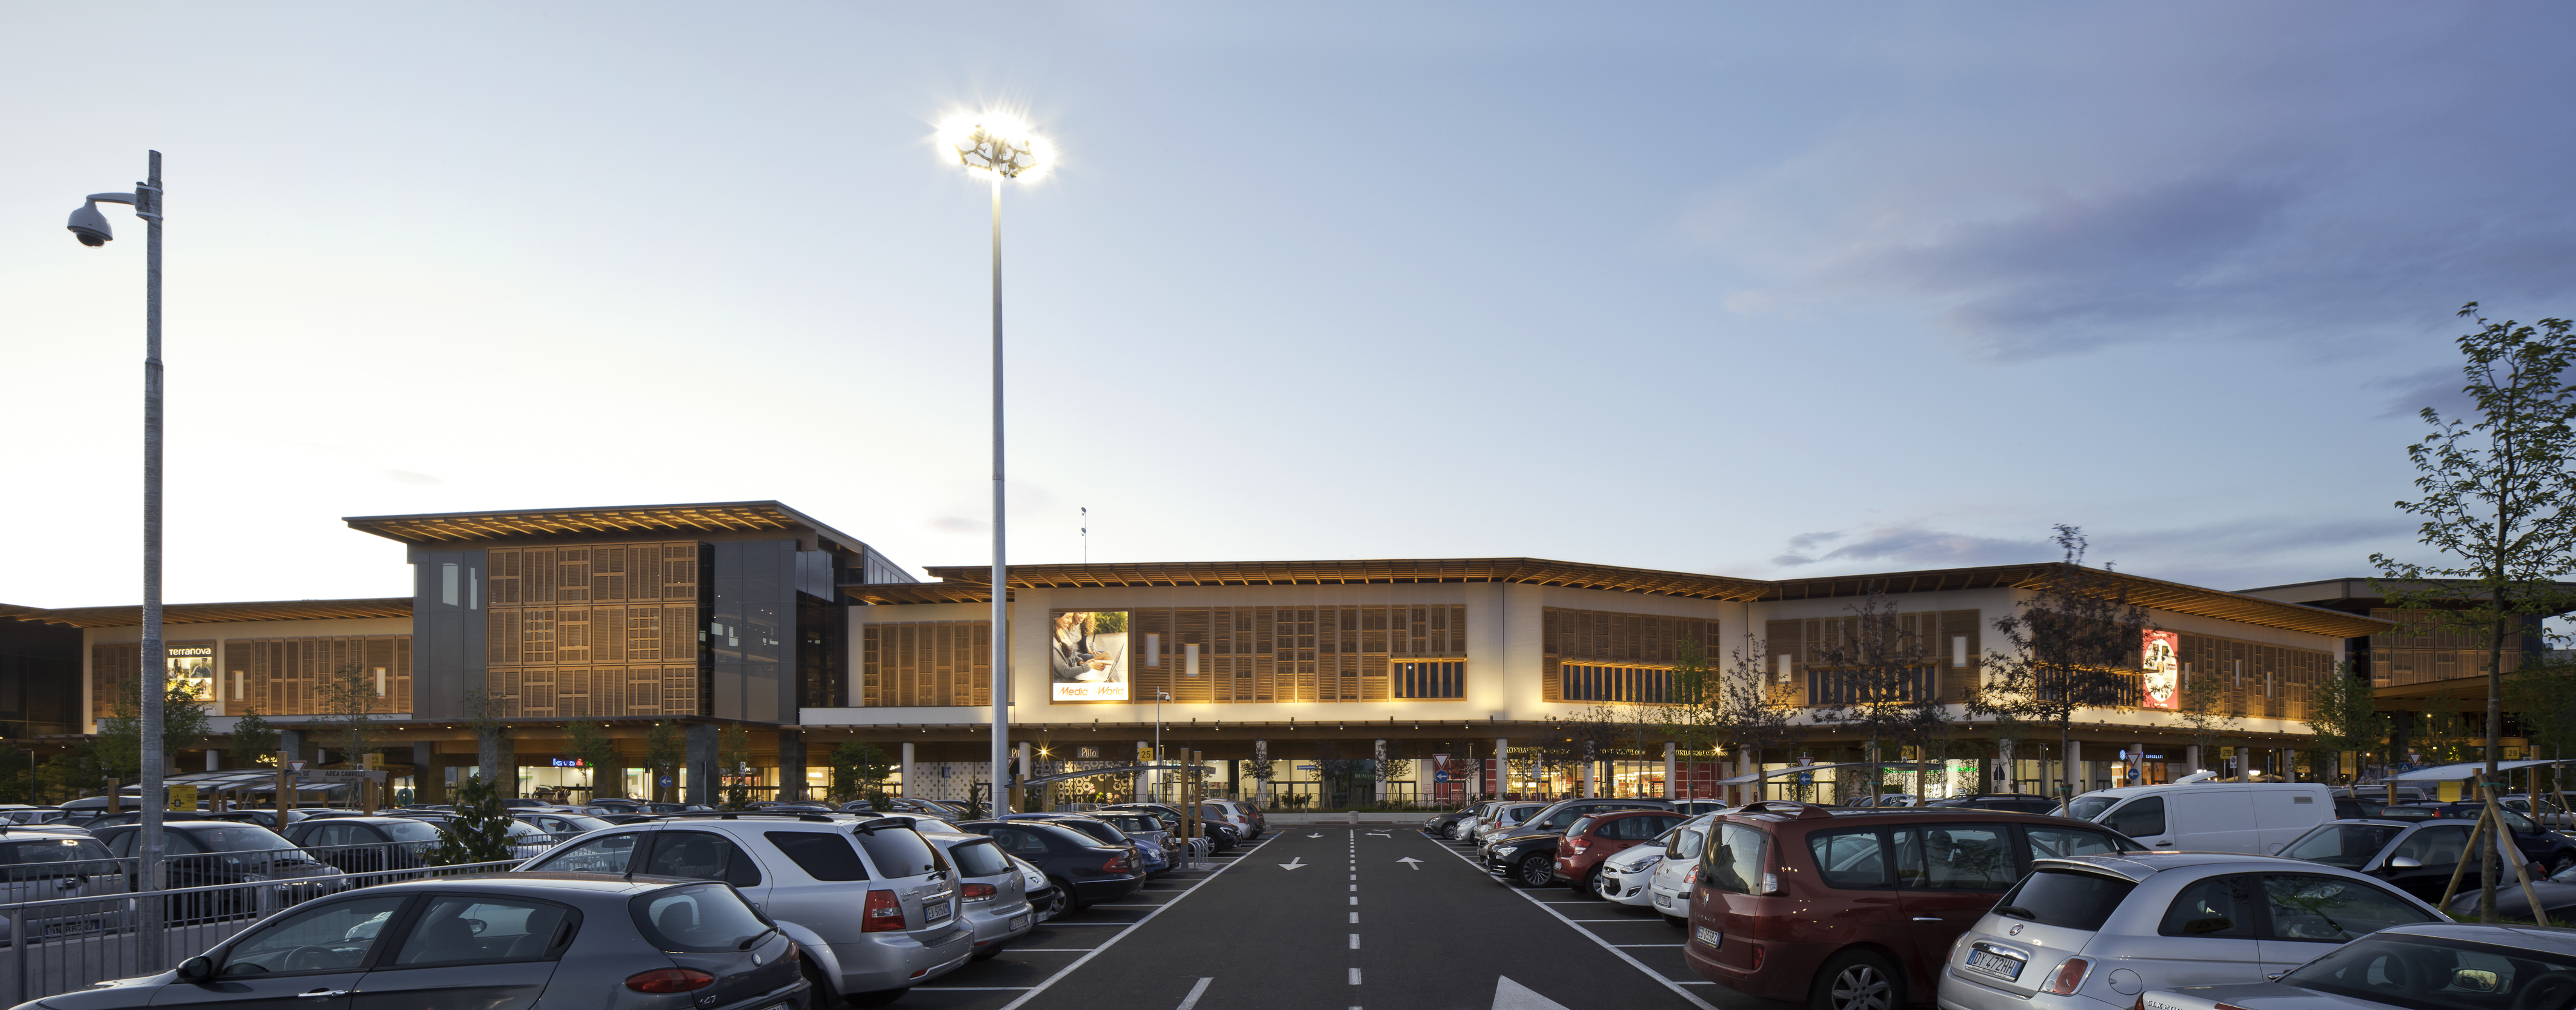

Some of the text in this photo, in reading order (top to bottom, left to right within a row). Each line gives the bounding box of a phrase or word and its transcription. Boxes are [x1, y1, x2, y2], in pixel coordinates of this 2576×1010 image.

[1058, 686, 1124, 696] Media World
[1081, 747, 1097, 757] Pillo
[2147, 1000, 2163, 1009] SLK
